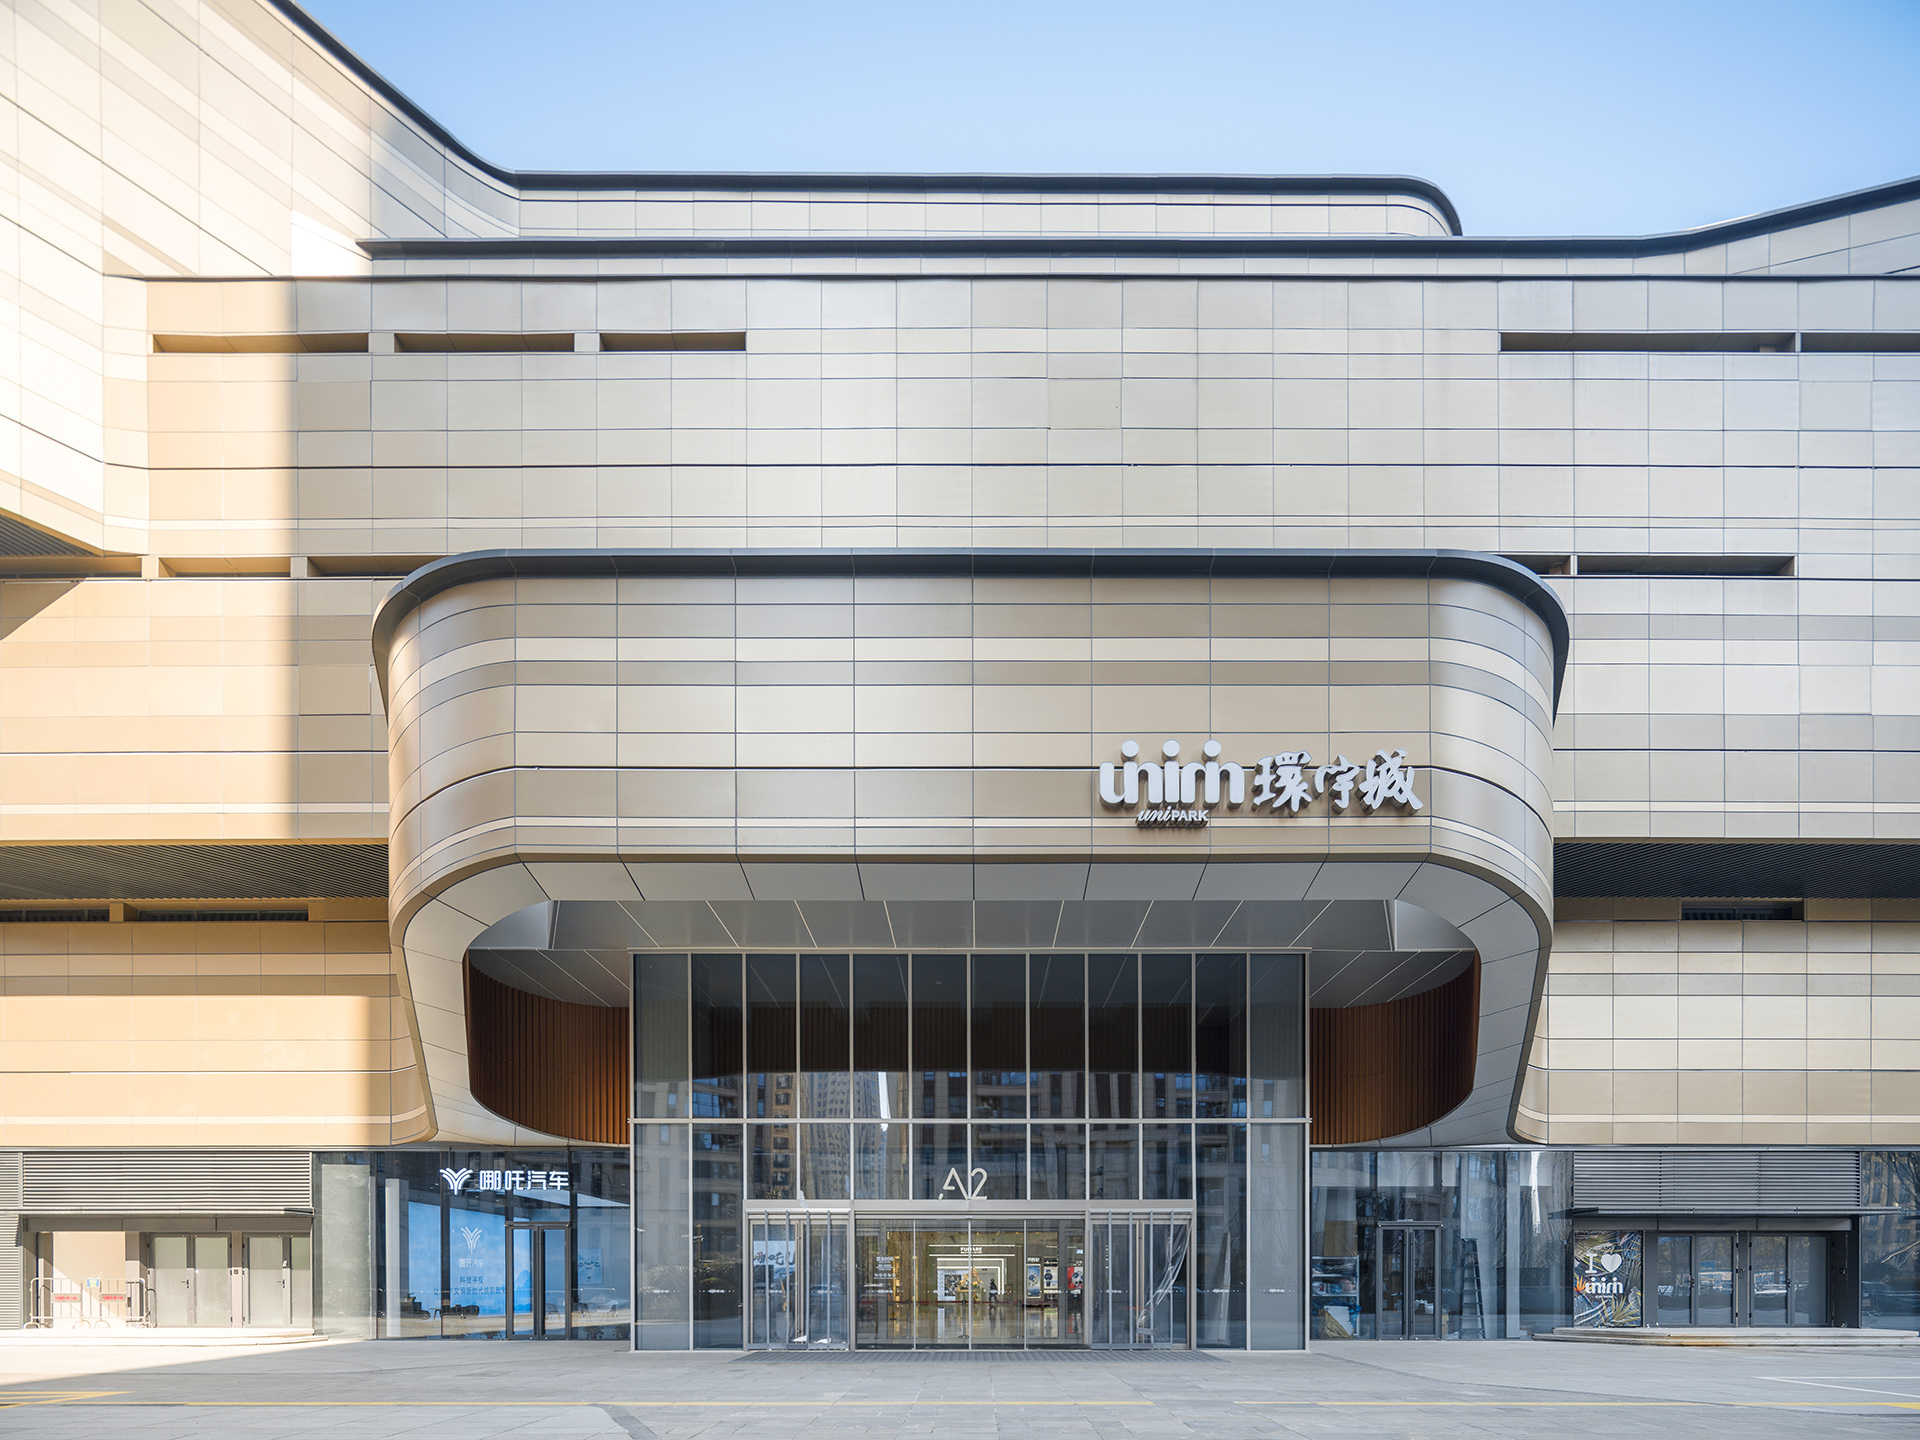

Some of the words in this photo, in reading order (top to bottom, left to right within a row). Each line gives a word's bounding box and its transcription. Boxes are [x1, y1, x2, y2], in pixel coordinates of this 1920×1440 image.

[479, 1170, 570, 1191] 哪吒汽车
[938, 1167, 988, 1200] A2
